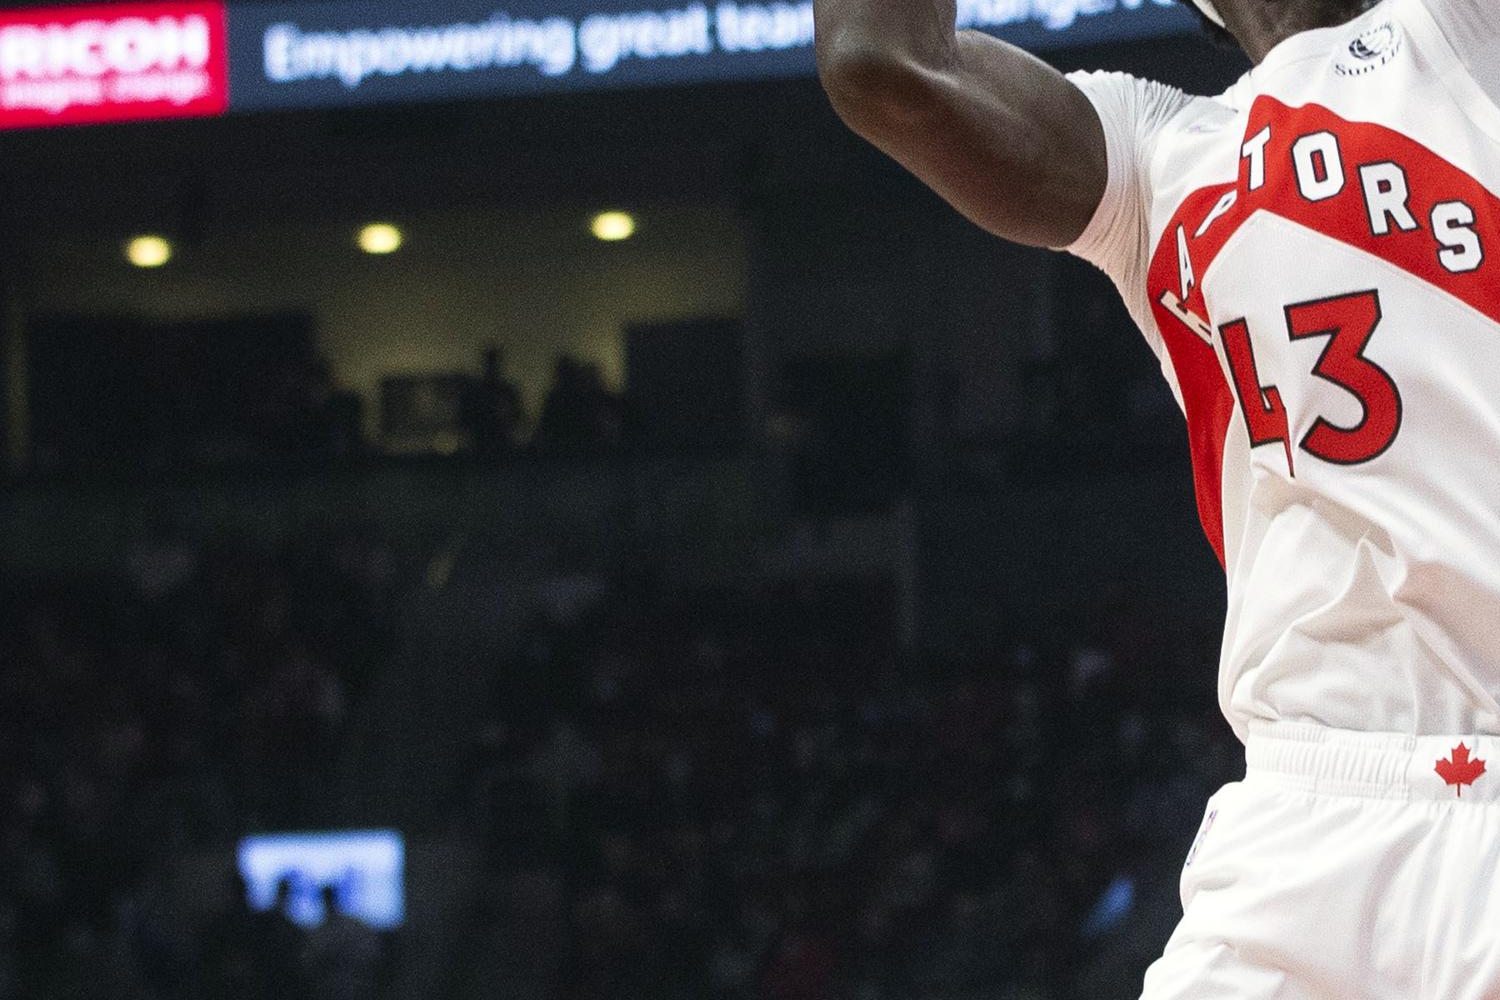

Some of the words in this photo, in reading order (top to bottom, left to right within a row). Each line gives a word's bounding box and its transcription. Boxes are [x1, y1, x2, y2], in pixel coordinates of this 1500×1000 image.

[0, 13, 209, 80] RICOH
[263, 11, 577, 87] Empowering
[578, 0, 709, 74] great
[1218, 288, 1403, 478] 43
